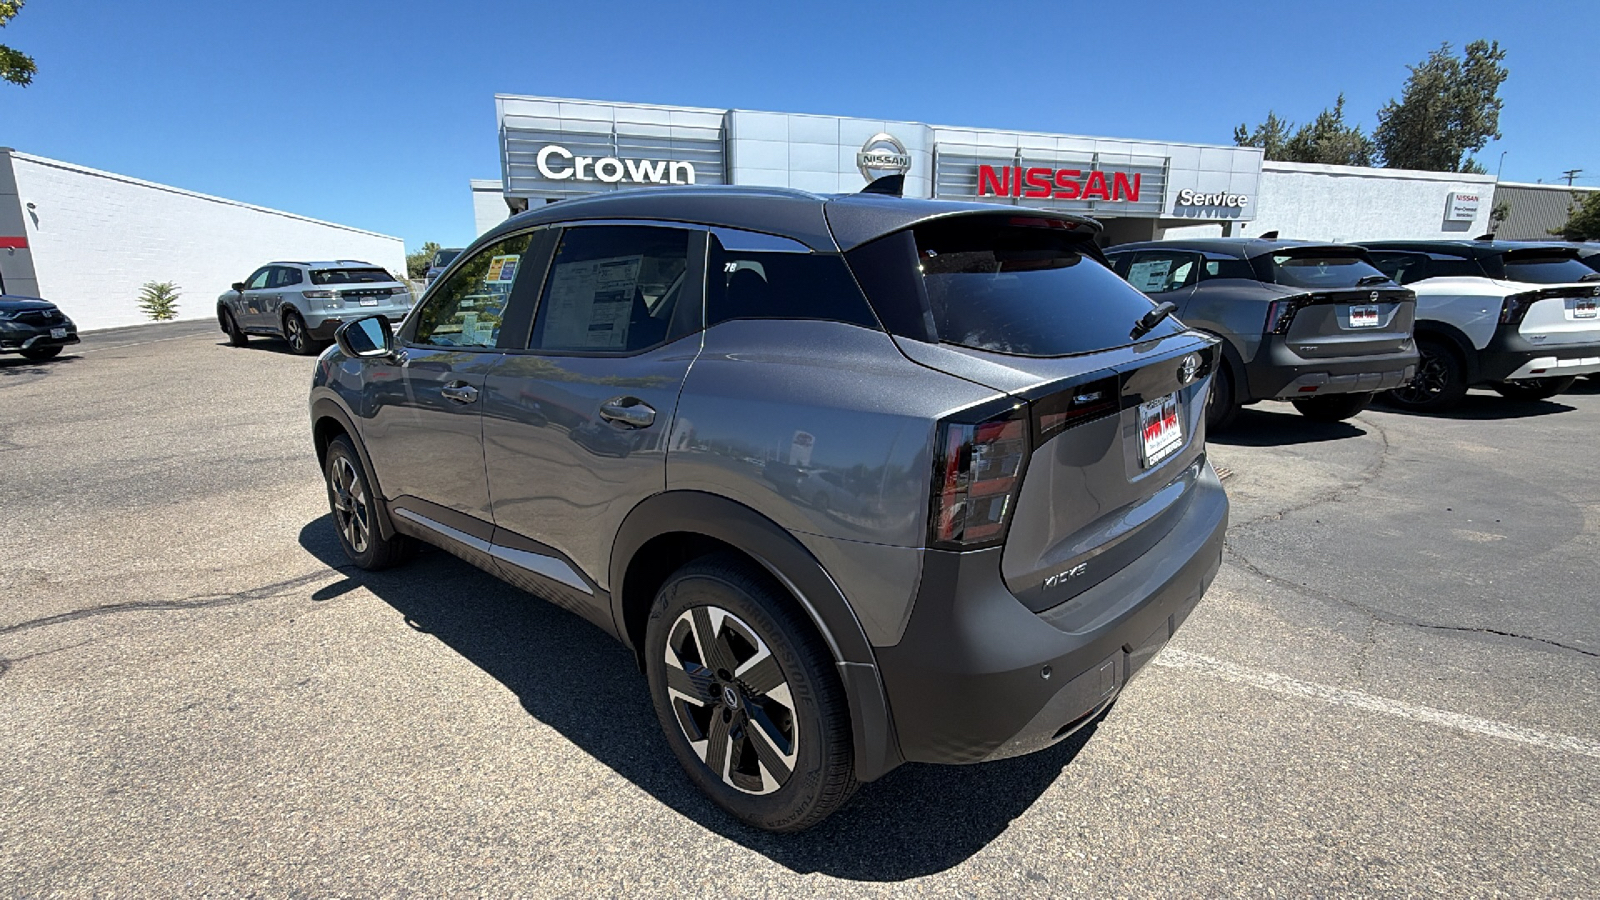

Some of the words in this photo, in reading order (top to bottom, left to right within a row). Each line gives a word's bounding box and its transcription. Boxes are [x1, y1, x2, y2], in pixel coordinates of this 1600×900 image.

[536, 145, 696, 185] Crown
[863, 155, 908, 166] NISSAN
[978, 164, 1141, 203] NISSAN
[1180, 188, 1249, 208] Service
[1456, 194, 1479, 202] NISSAN
